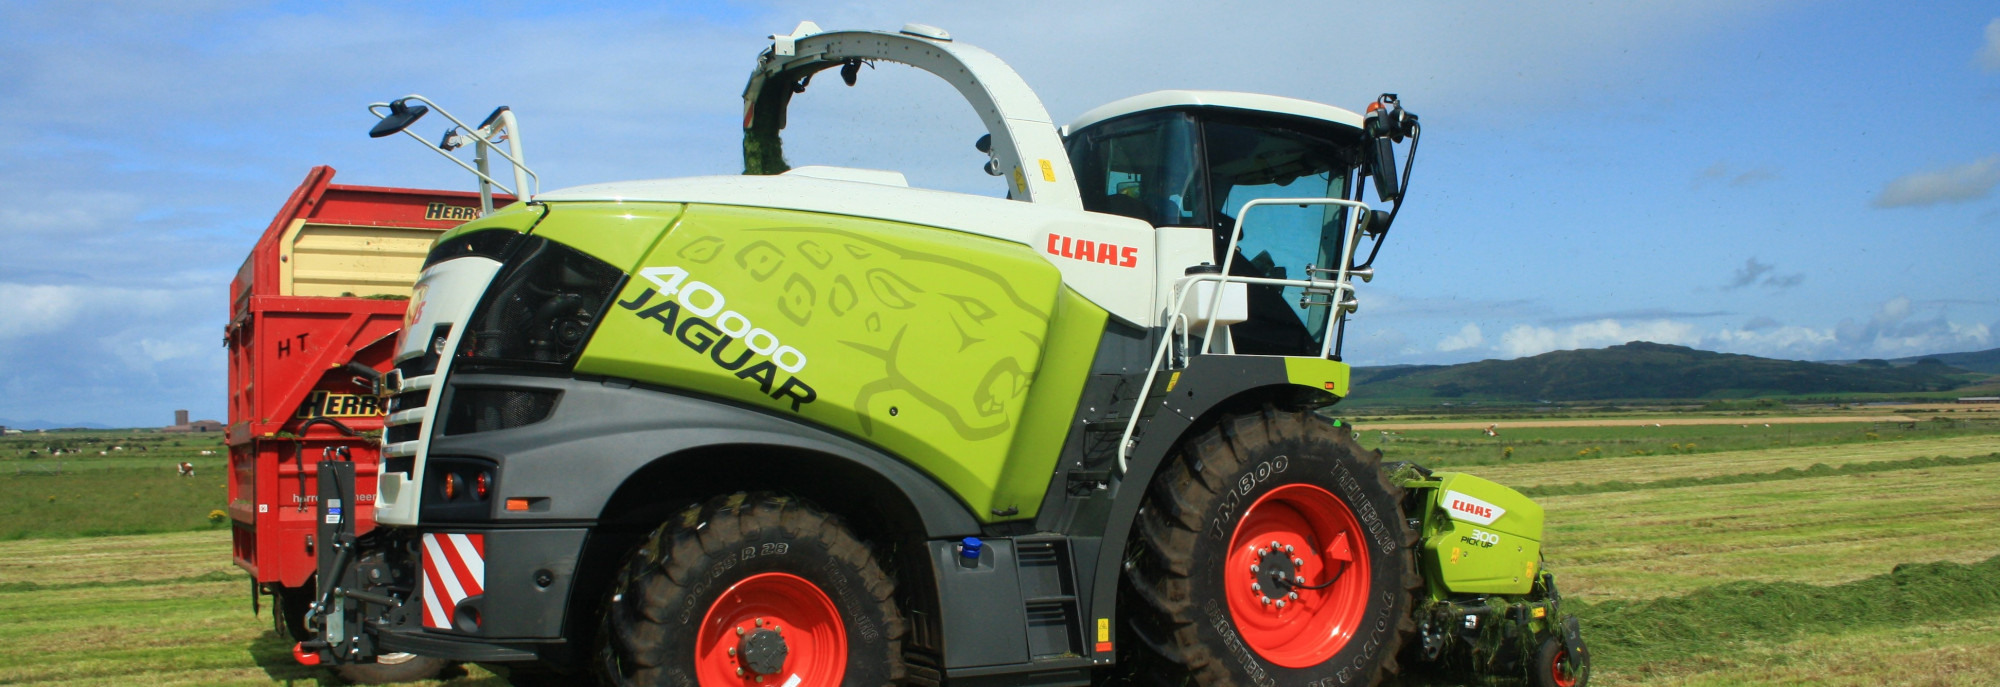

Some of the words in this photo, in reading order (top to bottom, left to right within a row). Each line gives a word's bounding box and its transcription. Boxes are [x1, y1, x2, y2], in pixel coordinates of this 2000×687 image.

[1047, 233, 1138, 268] CLAAS
[639, 266, 807, 373] 40000
[617, 287, 817, 412] JAGUAR
[1330, 459, 1396, 555] TRELLEBORG
[1452, 499, 1492, 518] CLAAS
[761, 542, 788, 556] 28
[1460, 536, 1480, 546] PICK
[1480, 540, 1493, 548] UP
[1471, 529, 1499, 545] 300
